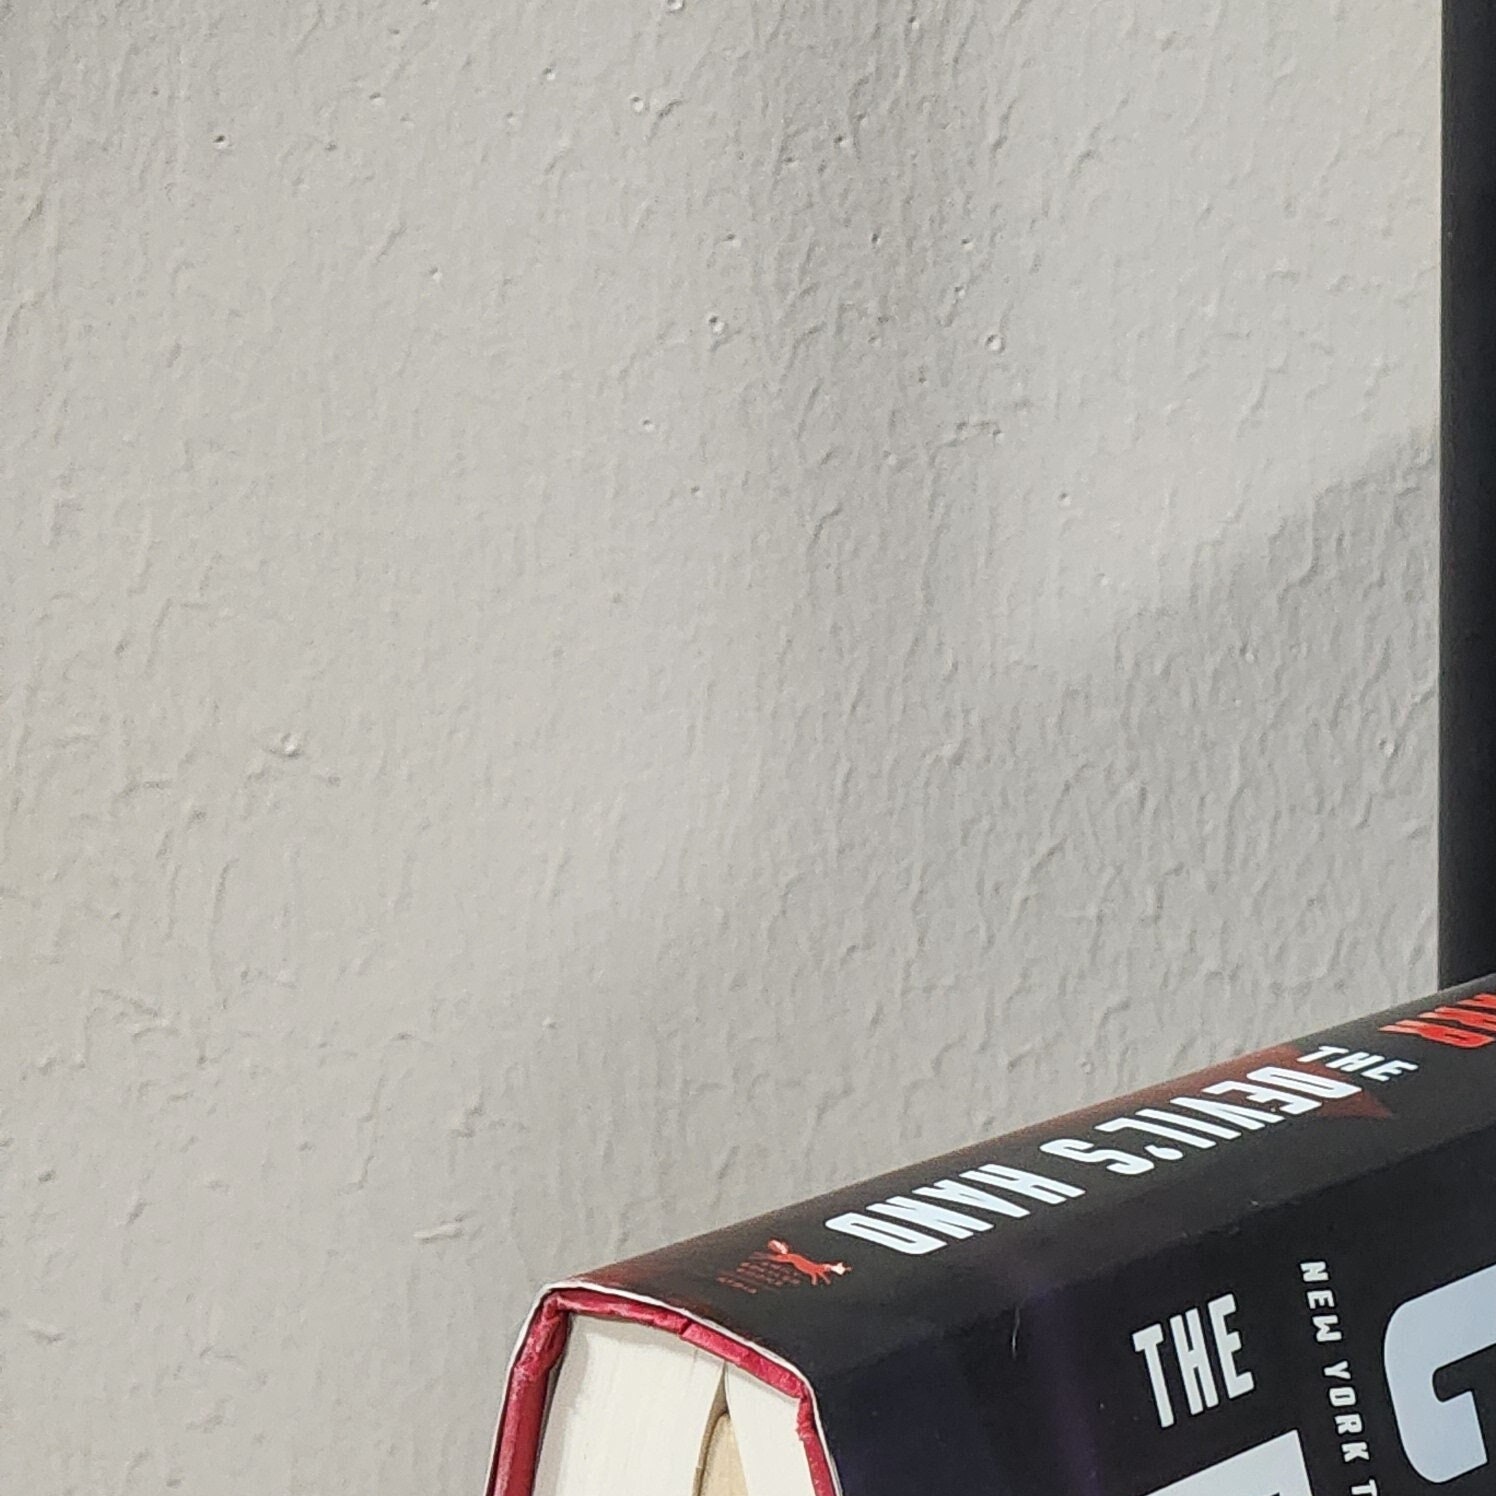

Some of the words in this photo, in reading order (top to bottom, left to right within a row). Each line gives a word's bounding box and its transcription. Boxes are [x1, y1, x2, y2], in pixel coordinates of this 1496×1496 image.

[1298, 1045, 1418, 1082] THE
[1040, 1067, 1361, 1174] DEVIL'S
[825, 1164, 1085, 1254] HAND
[1133, 1294, 1254, 1427] THE
[1301, 1262, 1341, 1341] NEW
[1325, 1361, 1369, 1461] YORK
